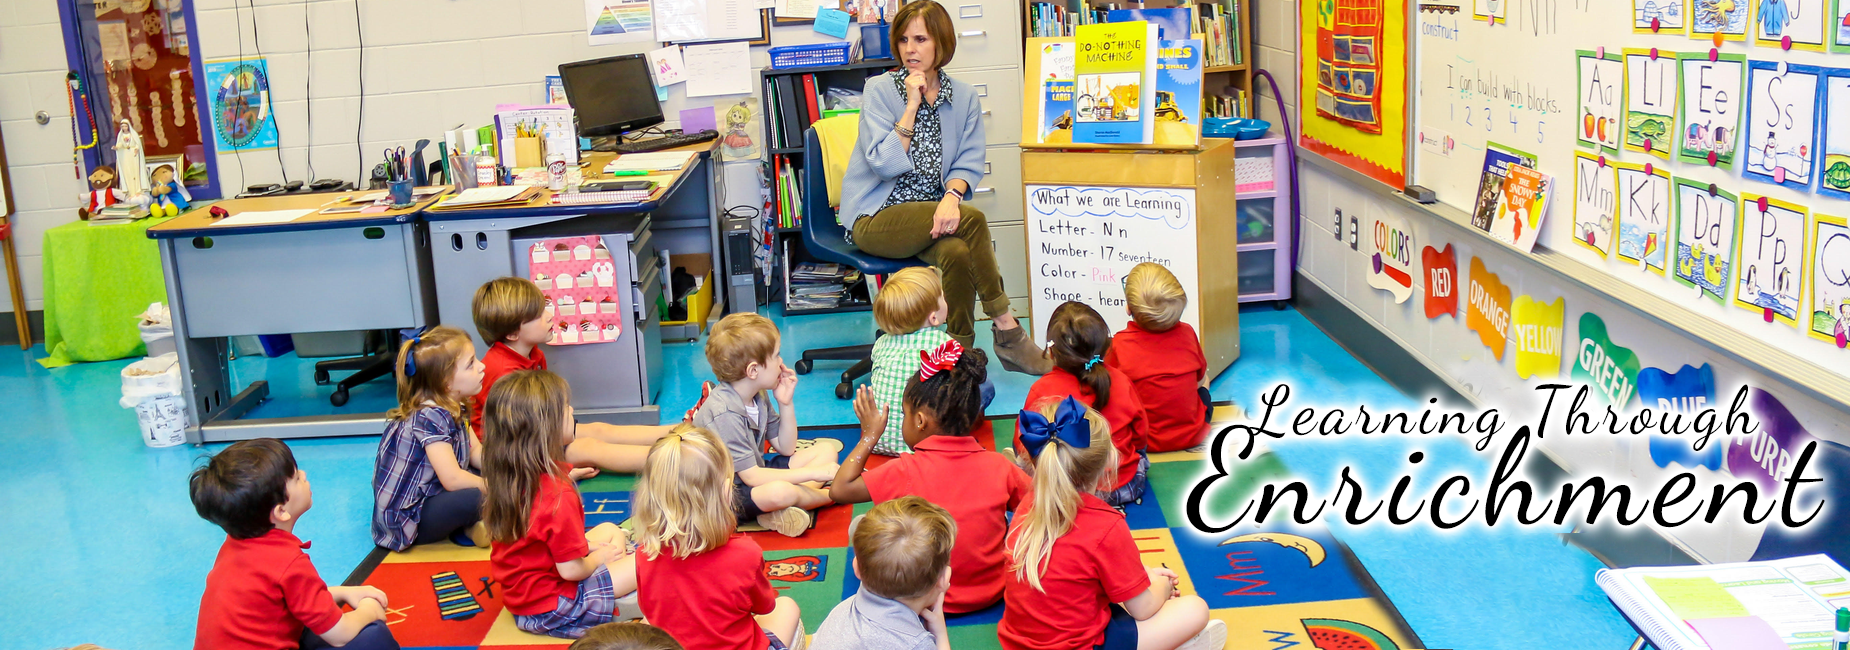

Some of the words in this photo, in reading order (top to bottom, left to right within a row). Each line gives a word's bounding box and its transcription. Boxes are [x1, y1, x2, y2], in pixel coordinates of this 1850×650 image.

[1421, 14, 1459, 42] construct
[1079, 39, 1141, 52] DO-NOTHING
[1086, 51, 1133, 63] MACHINE
[1157, 47, 1192, 58] INES
[1052, 93, 1072, 101] LARGE
[1447, 64, 1454, 89] I
[1459, 75, 1472, 91] can
[1477, 68, 1498, 98] build
[1503, 75, 1523, 104] with
[1527, 82, 1561, 113] blocks.
[1588, 63, 1613, 106] Aa
[1699, 65, 1728, 115] Ee
[1766, 76, 1794, 131] Ss
[1465, 106, 1473, 127] 2
[1484, 107, 1492, 132] 3
[1509, 111, 1518, 134] 4
[1537, 121, 1546, 143] 5
[1498, 168, 1507, 177] HEL
[1518, 177, 1531, 187] THE
[1580, 163, 1613, 213] Mm
[1037, 189, 1069, 206] What
[1076, 196, 1093, 207] we
[1103, 196, 1121, 208] are
[1126, 192, 1181, 218] Learning
[1509, 183, 1536, 200] SNOWY
[1511, 195, 1527, 208] DAY
[1629, 175, 1660, 225] Kk
[1694, 194, 1723, 248] Dd
[1100, 245, 1115, 261] 17
[1118, 251, 1171, 267] seventeen
[1374, 219, 1410, 267] COLORS
[1758, 211, 1787, 291] Pp
[1092, 267, 1116, 283] Pink
[1431, 267, 1450, 298] RED
[1099, 291, 1126, 307] hear
[1470, 280, 1509, 339] ORANGE
[1515, 323, 1563, 357] YELLOW
[1579, 337, 1633, 411] GREEN
[1736, 430, 1792, 483] URP
